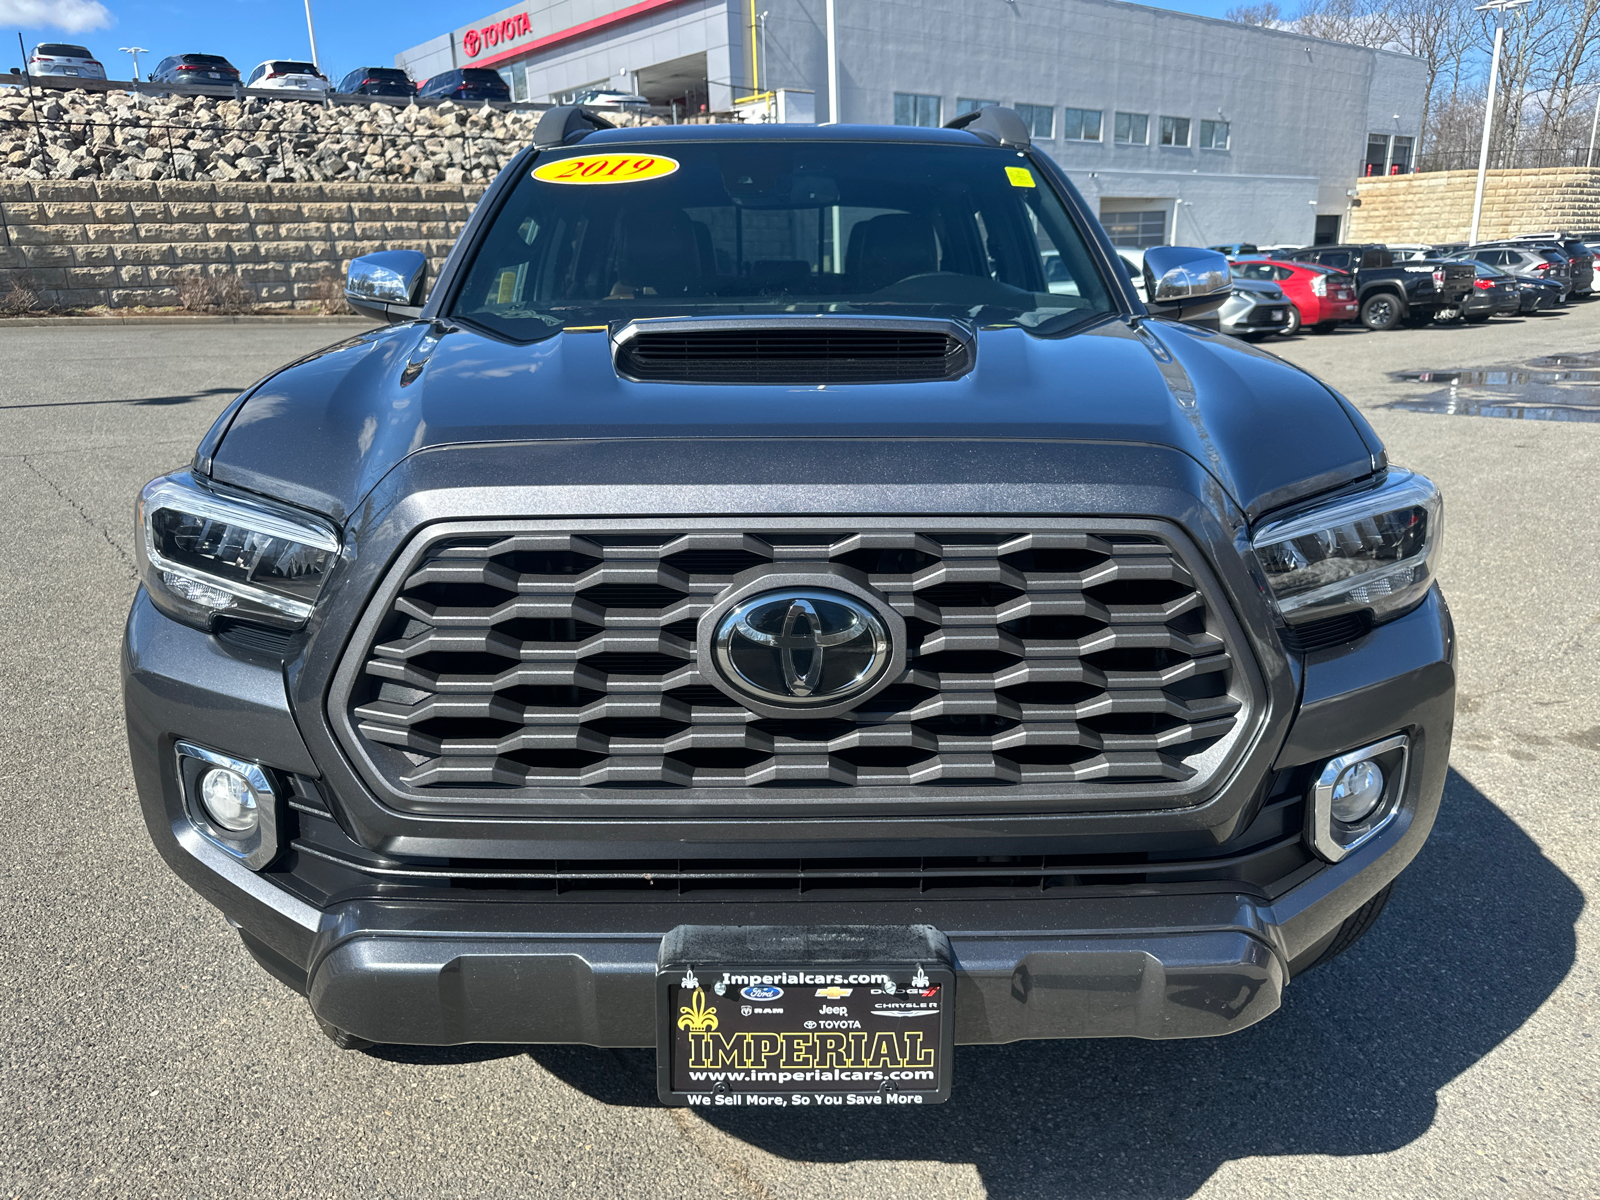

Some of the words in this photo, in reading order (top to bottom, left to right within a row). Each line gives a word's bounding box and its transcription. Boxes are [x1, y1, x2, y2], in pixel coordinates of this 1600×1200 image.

[481, 12, 532, 48] TOYOTA
[555, 158, 655, 178] 2019
[723, 972, 888, 987] Imperialcars.com
[750, 987, 774, 998] Ford
[819, 1005, 848, 1016] Jeep
[819, 1020, 861, 1029] TOYOTA
[689, 1032, 935, 1068] IMPERIAL
[689, 1070, 935, 1083] www.imperialcars.com
[687, 1094, 711, 1106] We
[714, 1094, 742, 1106] Sell
[746, 1094, 787, 1107] More,
[791, 1094, 811, 1106] So
[814, 1094, 843, 1106] You
[847, 1094, 883, 1106] Save
[886, 1093, 923, 1105] More
